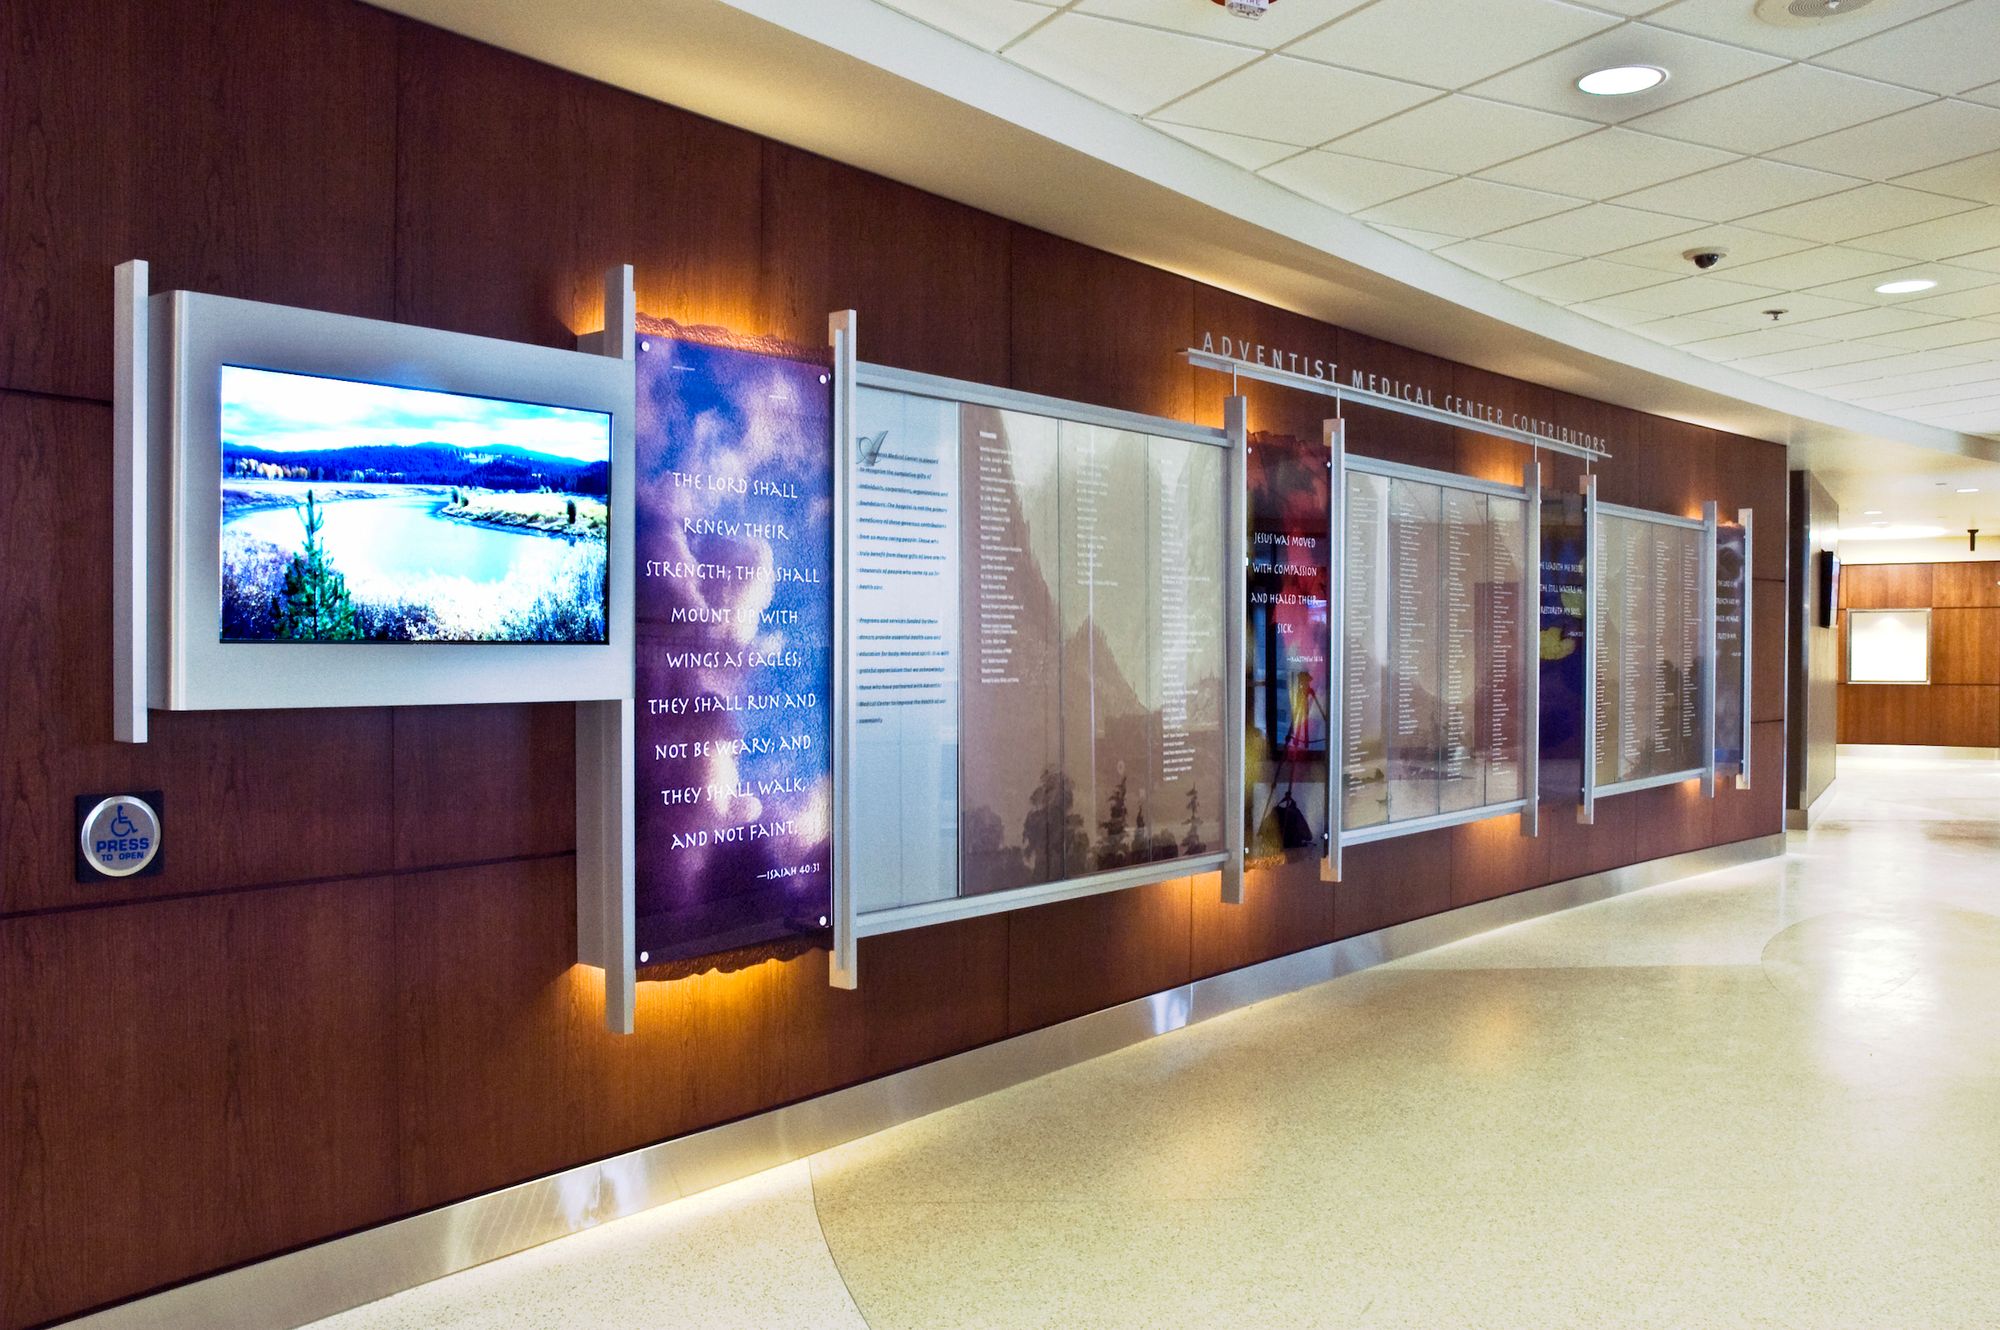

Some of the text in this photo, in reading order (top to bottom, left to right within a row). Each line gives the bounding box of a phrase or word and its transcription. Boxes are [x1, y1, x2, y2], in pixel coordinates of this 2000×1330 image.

[1202, 331, 1606, 453] ADVENTIST MEDICAL CENTER CONTRIBUTORS
[673, 472, 798, 498] THE LORD SHALL
[684, 517, 789, 540] RENEW THEIR
[1254, 532, 1315, 548] JESUS WAS MOVED
[646, 560, 820, 582] STRENGTH; THEY SHALL
[1253, 563, 1317, 576] WITH COMPASSION
[1251, 592, 1267, 603] AND
[1270, 593, 1296, 604] HEALED
[671, 608, 798, 624] MOUNT UP WITH
[666, 651, 801, 668] WINGS AS EAGLES;
[648, 693, 816, 714] THEY SHALL RUN AND
[655, 735, 811, 760] NOT BE WEARY; AND
[662, 778, 806, 805] THEY SHALL WALK,
[671, 821, 798, 849] AND NOT FAINT.
[96, 837, 149, 853] PRESS
[119, 851, 144, 860] OPEN
[800, 863, 820, 874] 40:31
